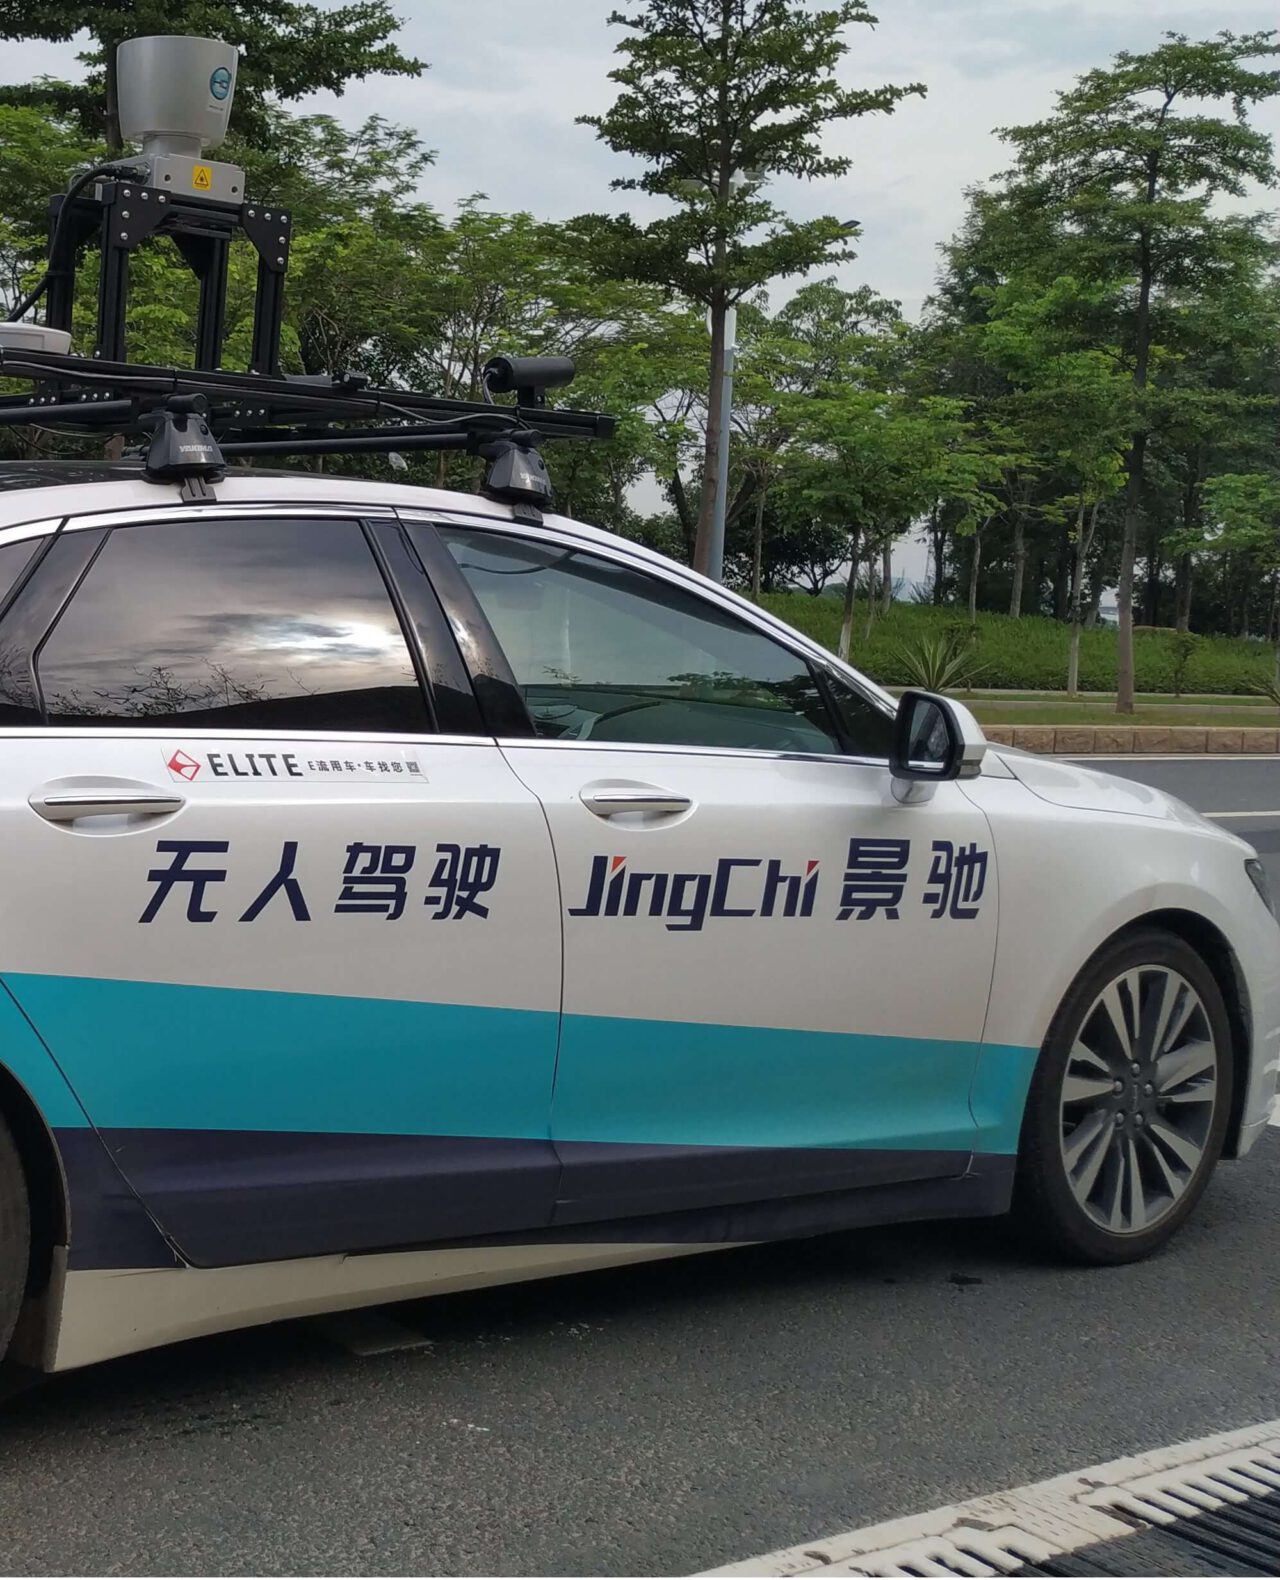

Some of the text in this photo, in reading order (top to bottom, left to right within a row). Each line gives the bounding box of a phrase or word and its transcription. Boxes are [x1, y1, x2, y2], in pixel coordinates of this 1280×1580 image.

[206, 753, 304, 777] ELITE
[138, 840, 501, 923] 无人驾驶
[567, 837, 989, 931] JingChi 景驰
